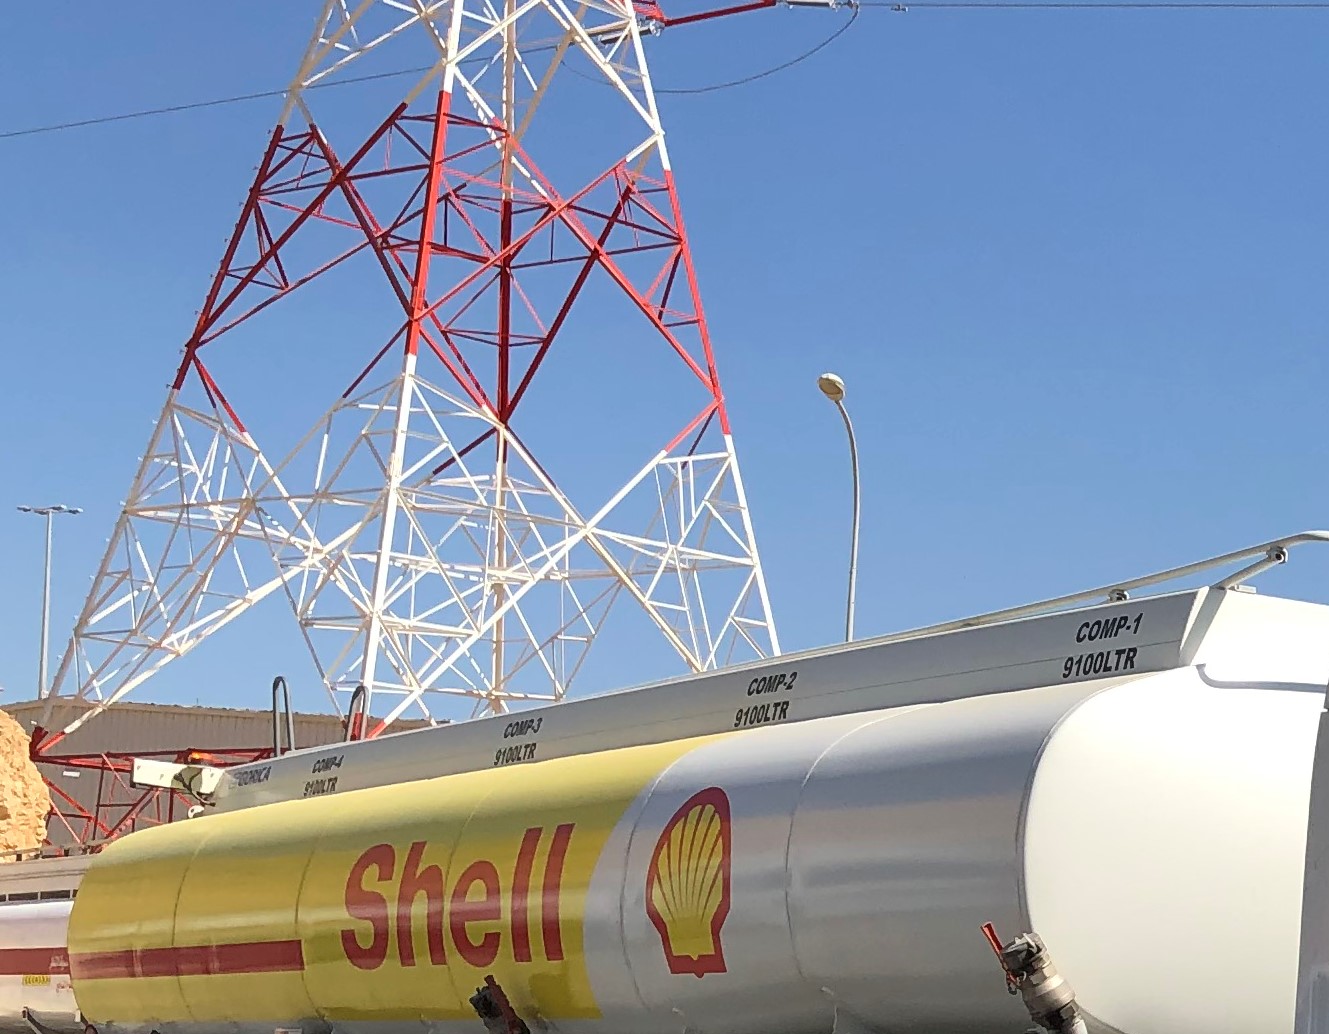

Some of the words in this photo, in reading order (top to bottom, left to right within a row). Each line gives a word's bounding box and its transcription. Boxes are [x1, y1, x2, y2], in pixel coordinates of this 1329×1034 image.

[1076, 612, 1144, 643] COMP-1
[1062, 647, 1138, 679] 9100LTR
[747, 671, 798, 697] COMP-2
[734, 700, 790, 727] 9100LTR
[503, 717, 544, 739] COMP-3
[311, 754, 345, 775] COMP-4
[493, 743, 538, 766] 9100LTR
[341, 822, 576, 970] Shell
